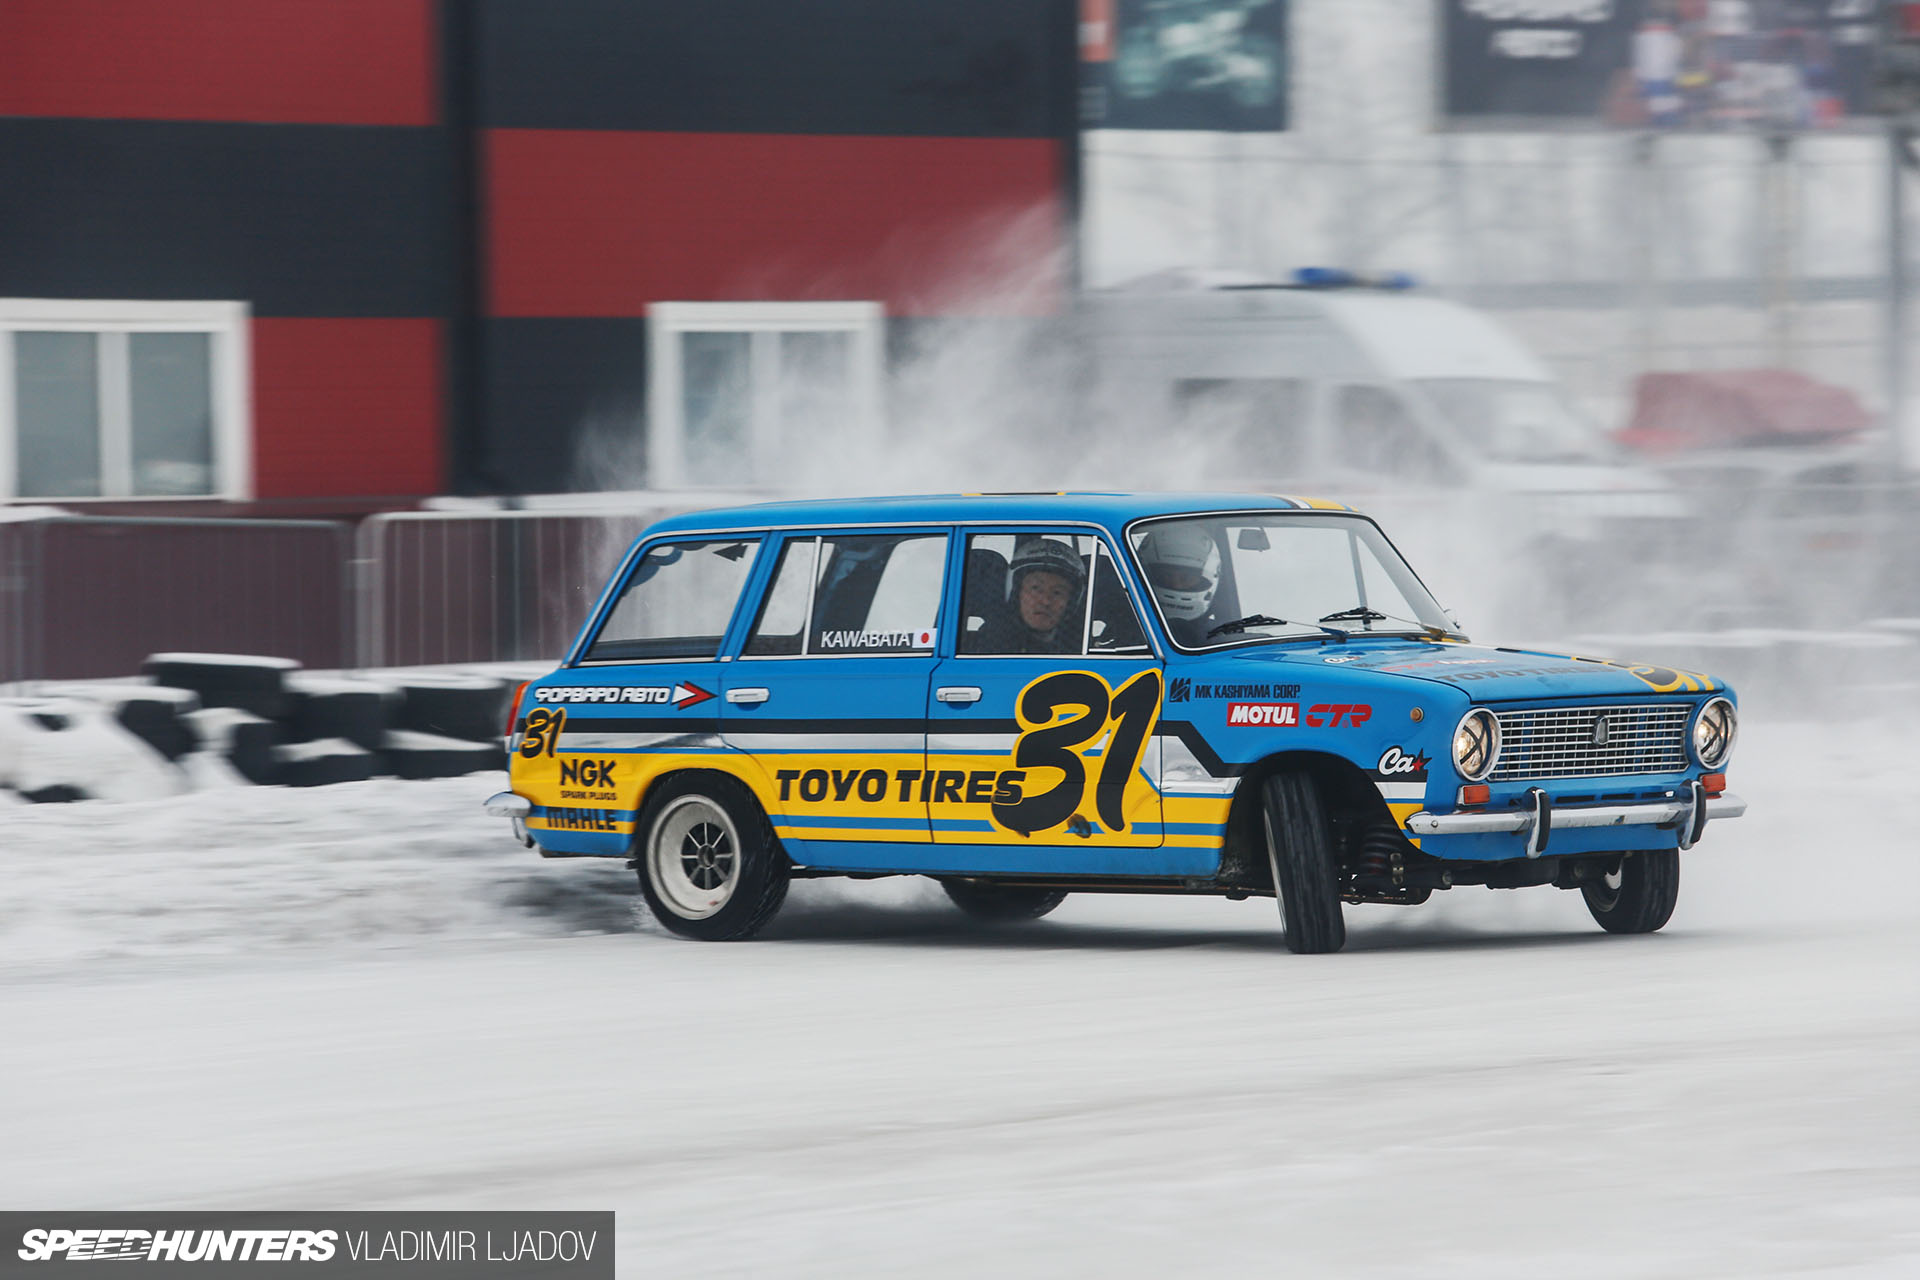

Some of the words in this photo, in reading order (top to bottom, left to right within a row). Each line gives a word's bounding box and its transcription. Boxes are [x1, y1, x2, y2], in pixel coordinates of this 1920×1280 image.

[821, 630, 910, 648] KAWABATA
[1433, 669, 1525, 683] TOYO
[1195, 685, 1212, 699] MK
[1214, 685, 1271, 699] KASHIYAMA
[1230, 705, 1296, 724] MOTUL
[1306, 704, 1372, 728] CTR
[520, 708, 566, 758] 31
[991, 668, 1164, 836] 31
[560, 759, 617, 788] NGK
[560, 790, 586, 799] SPARK
[589, 791, 617, 801] PLUGS
[776, 769, 888, 802] TOYO
[895, 770, 1027, 806] TIRES
